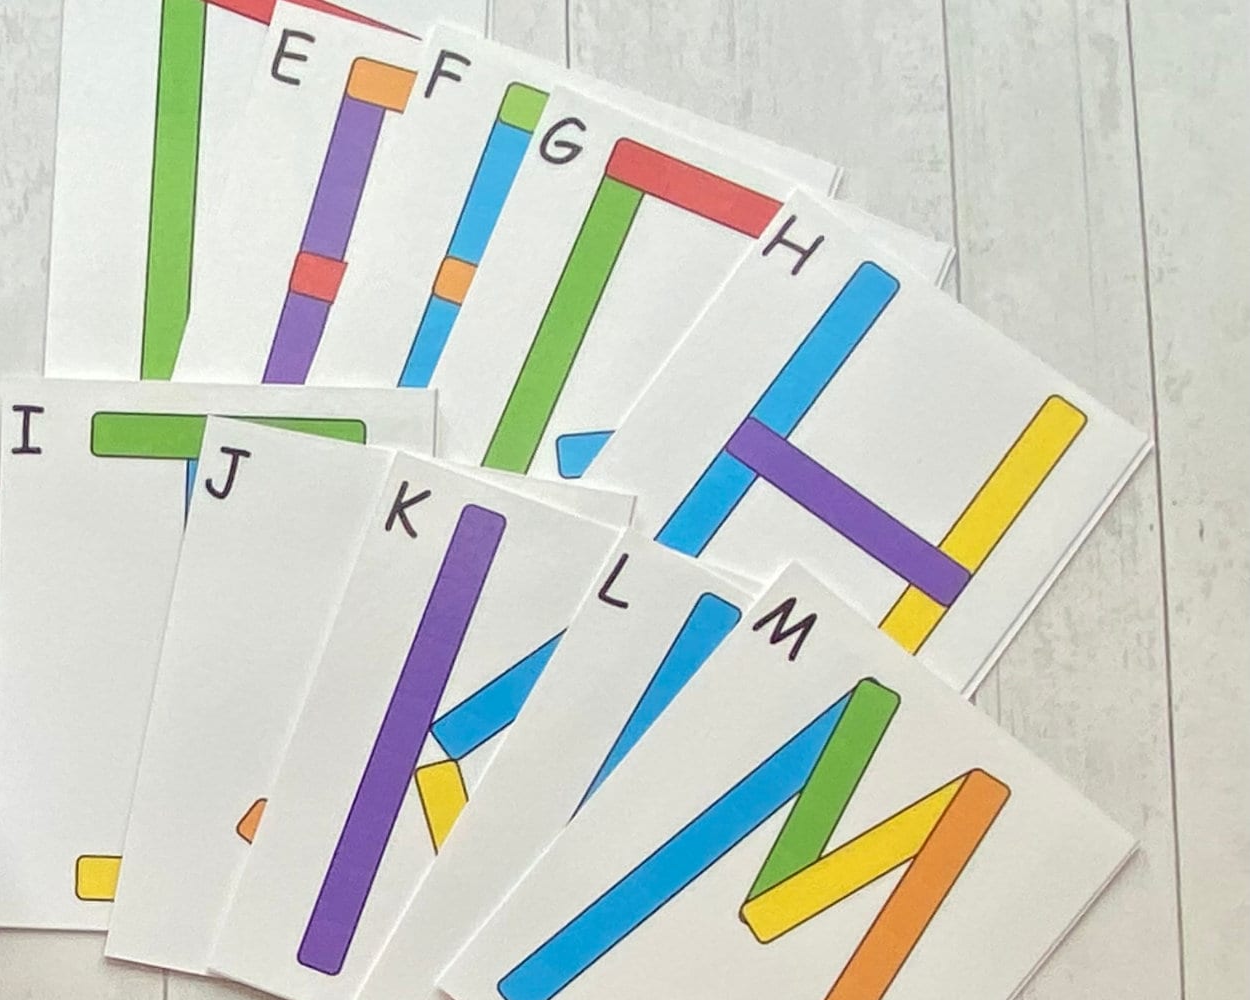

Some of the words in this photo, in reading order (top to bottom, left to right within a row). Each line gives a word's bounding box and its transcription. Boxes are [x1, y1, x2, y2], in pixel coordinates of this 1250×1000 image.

[270, 29, 315, 85] E
[425, 51, 471, 98] F
[540, 117, 586, 165] G
[762, 215, 825, 276] H
[12, 405, 44, 455] I
[205, 447, 251, 500] J
[385, 481, 431, 538] K
[598, 553, 629, 609] L
[752, 597, 817, 661] M
